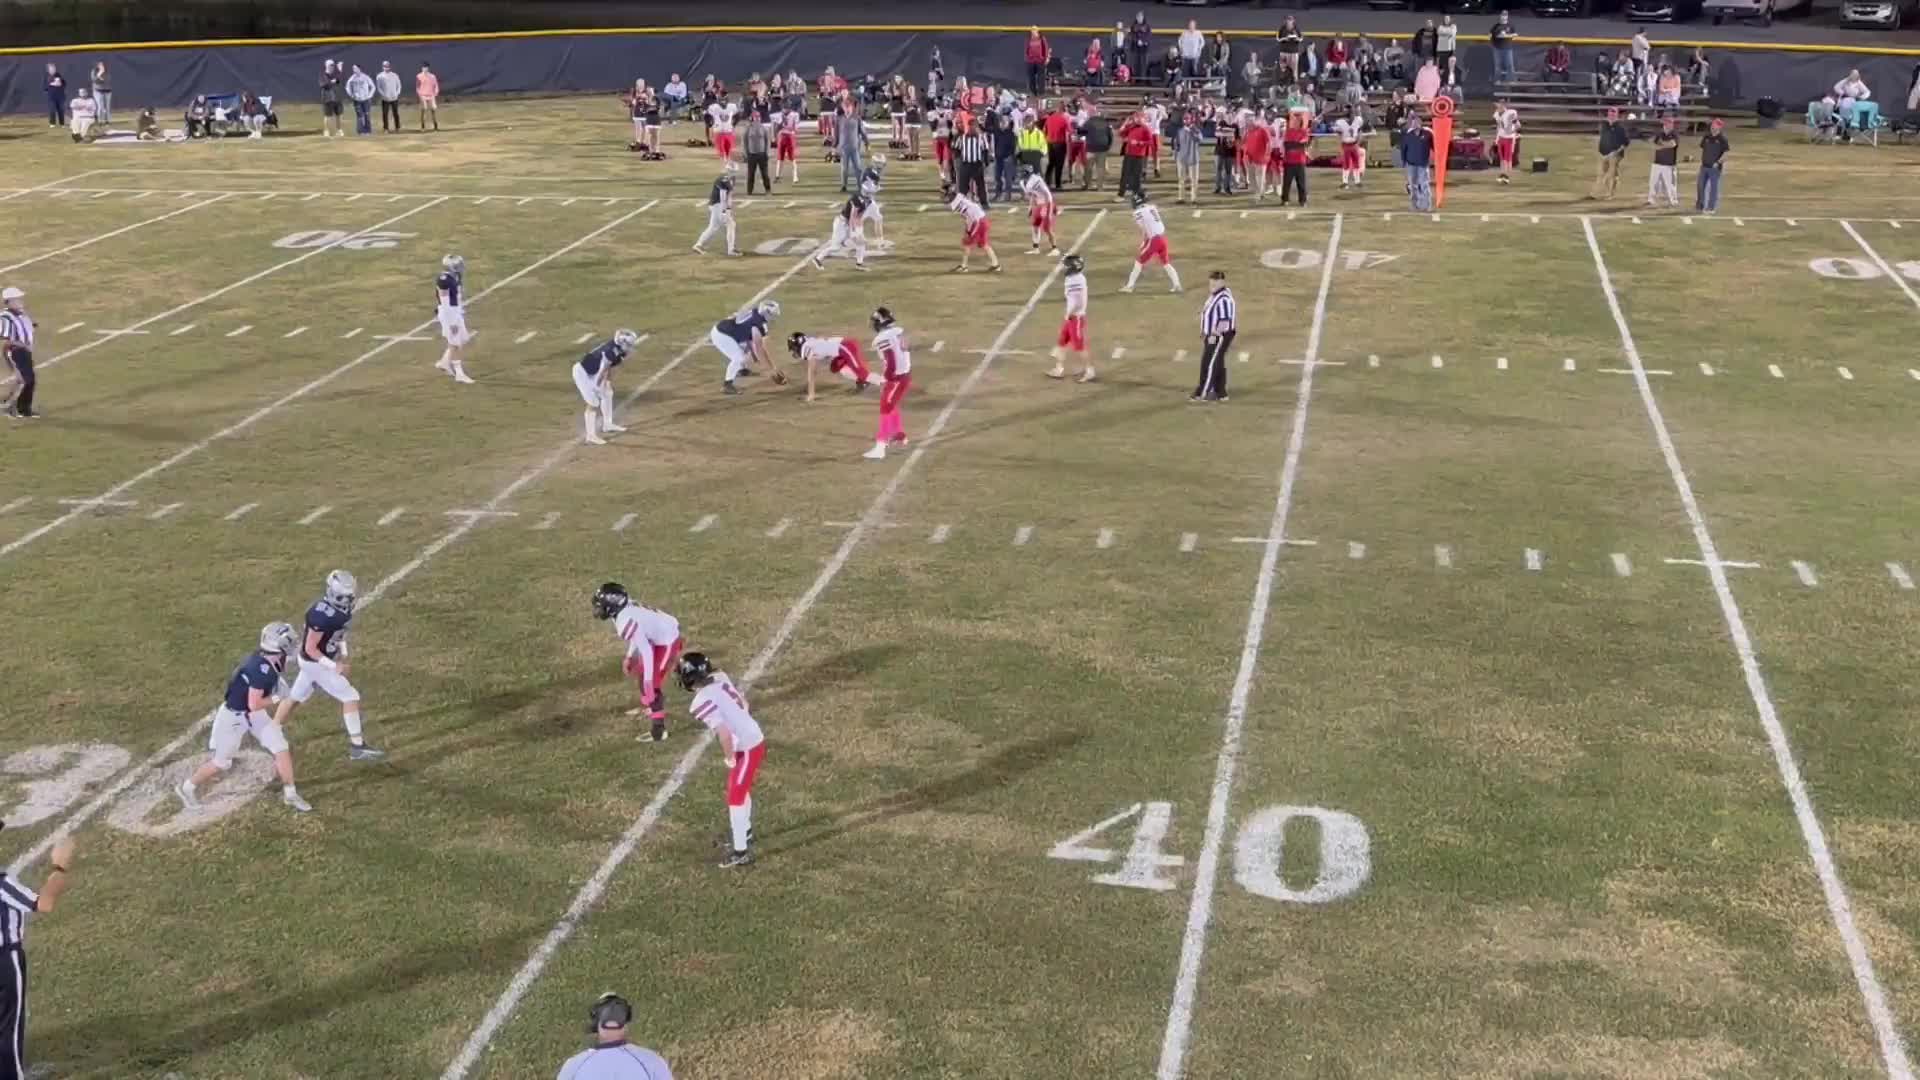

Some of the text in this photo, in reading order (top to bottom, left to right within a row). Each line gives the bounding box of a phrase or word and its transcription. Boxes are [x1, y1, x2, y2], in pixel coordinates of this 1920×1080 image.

[272, 230, 419, 250] 20
[1261, 248, 1402, 271] 40
[0, 741, 277, 838] 30
[1048, 801, 1371, 905] 40
